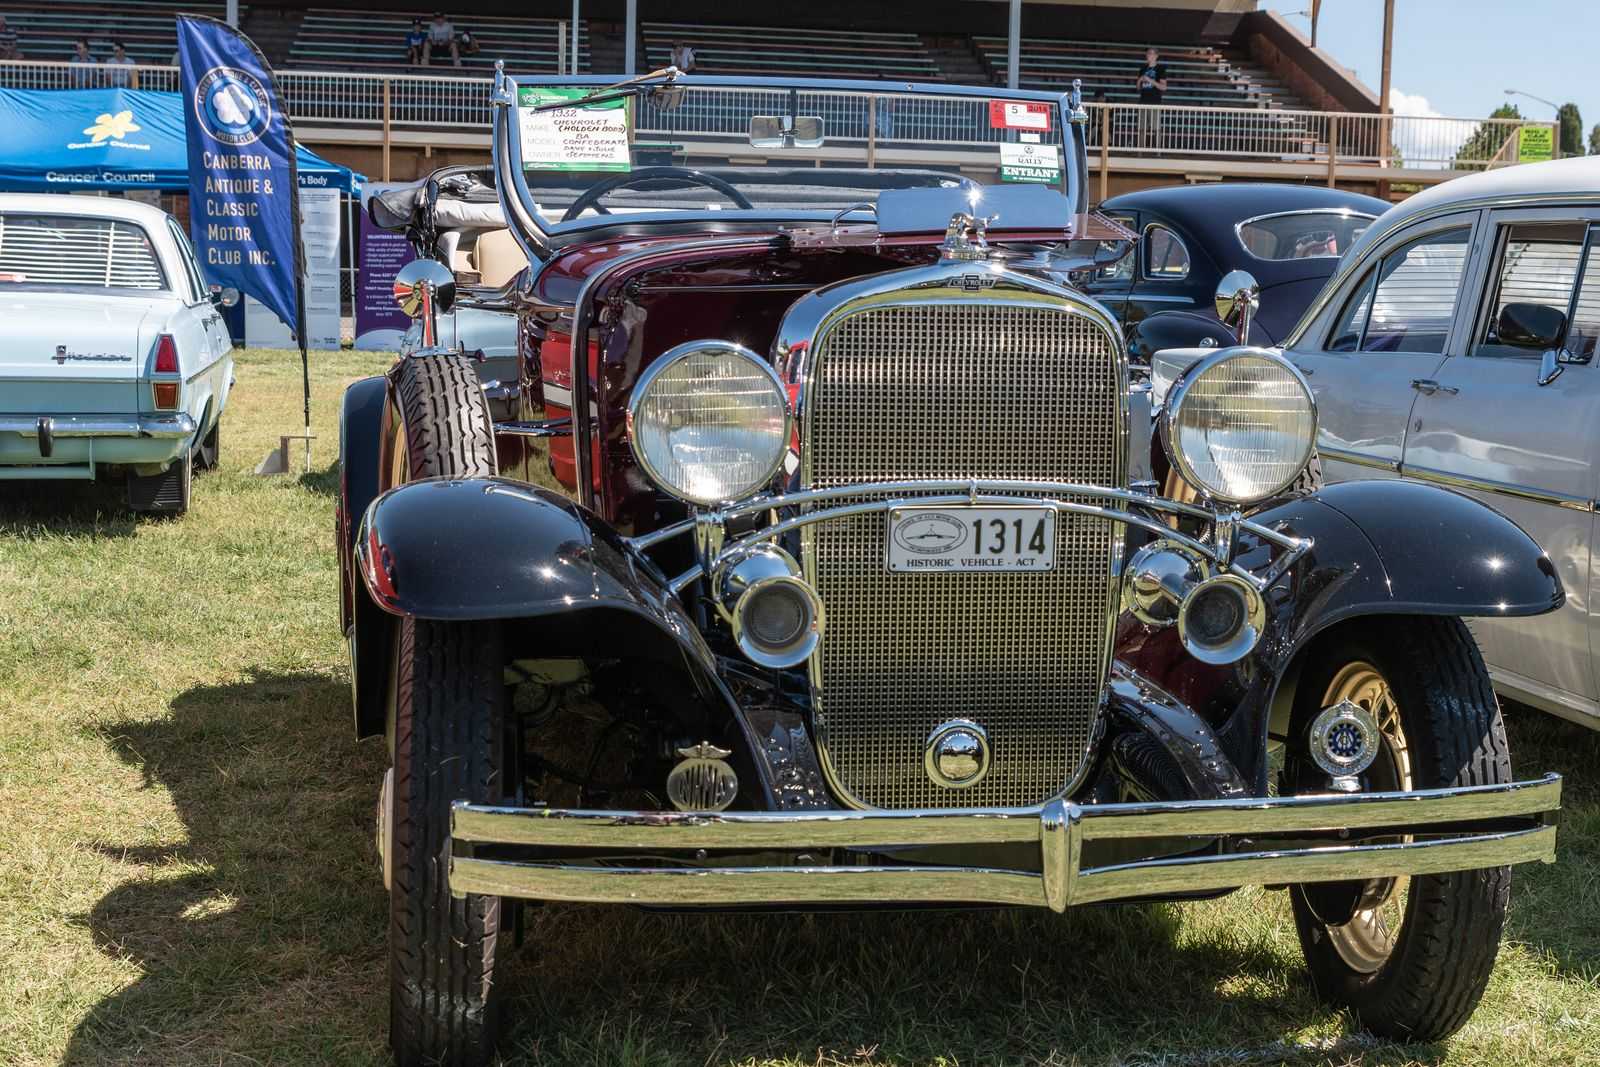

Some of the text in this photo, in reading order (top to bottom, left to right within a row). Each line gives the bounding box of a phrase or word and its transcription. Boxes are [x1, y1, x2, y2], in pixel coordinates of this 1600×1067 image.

[203, 151, 272, 170] CANBERRA
[1018, 157, 1043, 165] RALLY
[46, 171, 156, 183] Cancer Council
[307, 175, 328, 185] Body
[1002, 167, 1058, 178] ENTRANT
[205, 176, 275, 195] ANTIQUE &
[207, 199, 259, 217] CLASSIC
[208, 223, 252, 241] MOTOR
[208, 247, 276, 265] CLUB INC.
[952, 279, 992, 287] CHEVROLET
[973, 517, 1046, 554] 1314
[906, 558, 954, 568] HISTORIC
[961, 558, 1004, 567] VEHICLE
[1015, 558, 1036, 567] ACT
